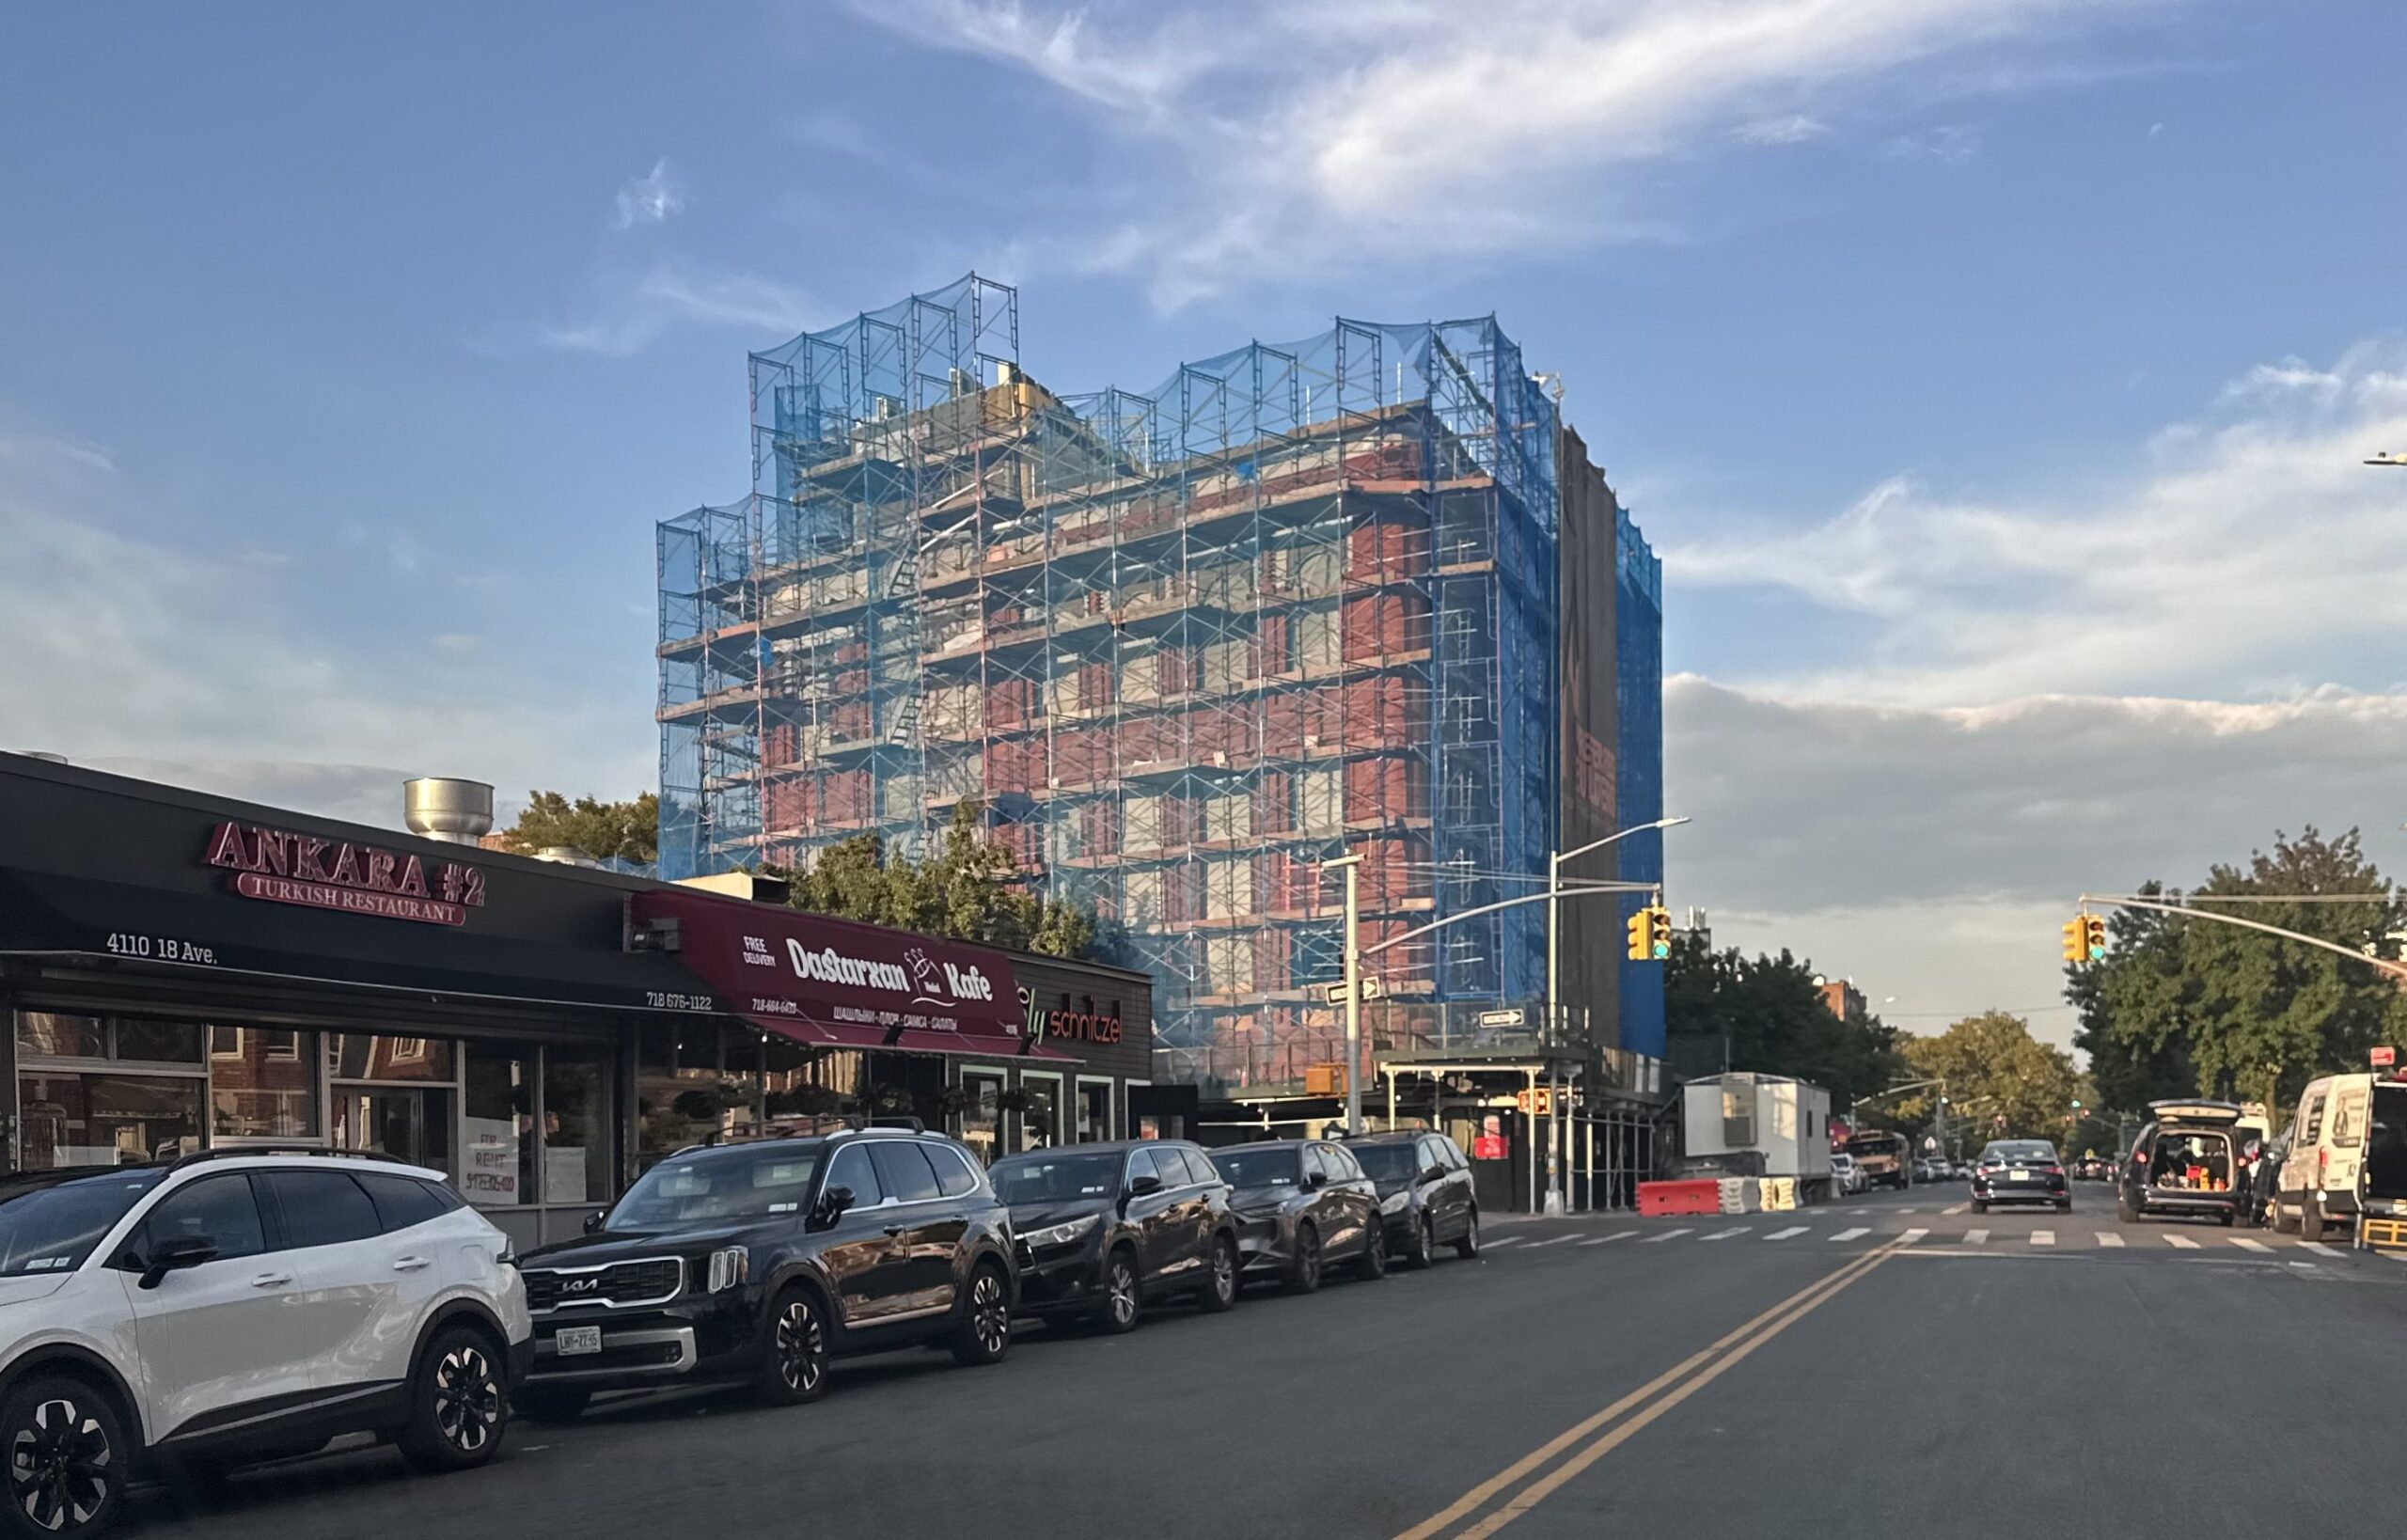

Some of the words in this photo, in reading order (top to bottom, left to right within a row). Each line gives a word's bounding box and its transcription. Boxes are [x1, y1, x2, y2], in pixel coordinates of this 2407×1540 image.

[204, 821, 431, 899] ANKARA
[436, 863, 485, 906] #2
[251, 876, 337, 905] TURKISH
[342, 891, 456, 922] RESTAURANT
[106, 933, 149, 956] 4110
[157, 938, 178, 959] 18
[181, 941, 217, 965] Ave.
[743, 935, 767, 953] FREE
[743, 951, 776, 966] DELIVERY
[786, 937, 910, 992] Dastarxan
[943, 962, 993, 1001] Kafe
[646, 992, 666, 1007] 718
[666, 994, 713, 1011] 676-1122
[1050, 991, 1123, 1044] schnitzel
[562, 1279, 598, 1292] KIA
